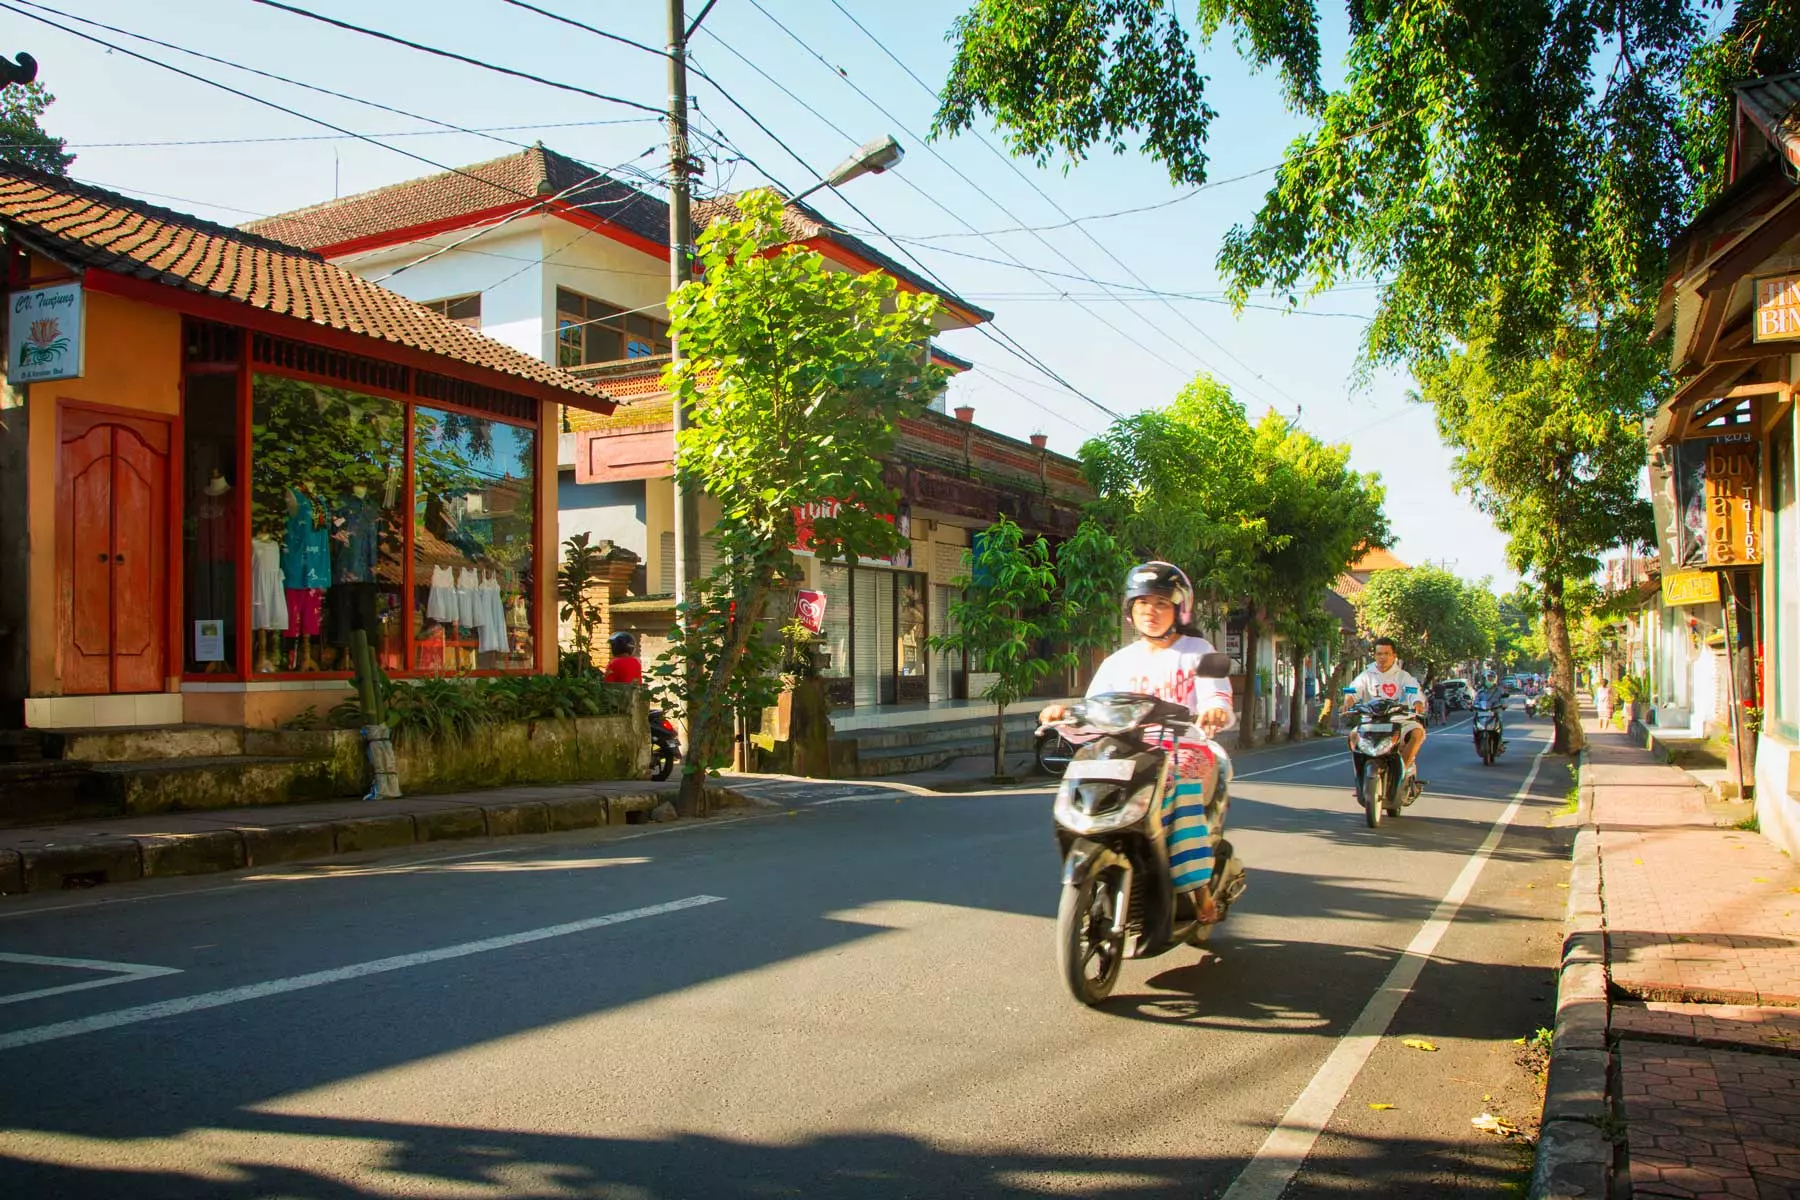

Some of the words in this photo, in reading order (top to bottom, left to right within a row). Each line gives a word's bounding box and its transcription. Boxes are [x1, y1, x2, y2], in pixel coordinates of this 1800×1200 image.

[36, 291, 74, 309] Tunjung
[1709, 445, 1756, 485] buy
[1712, 478, 1732, 562] made
